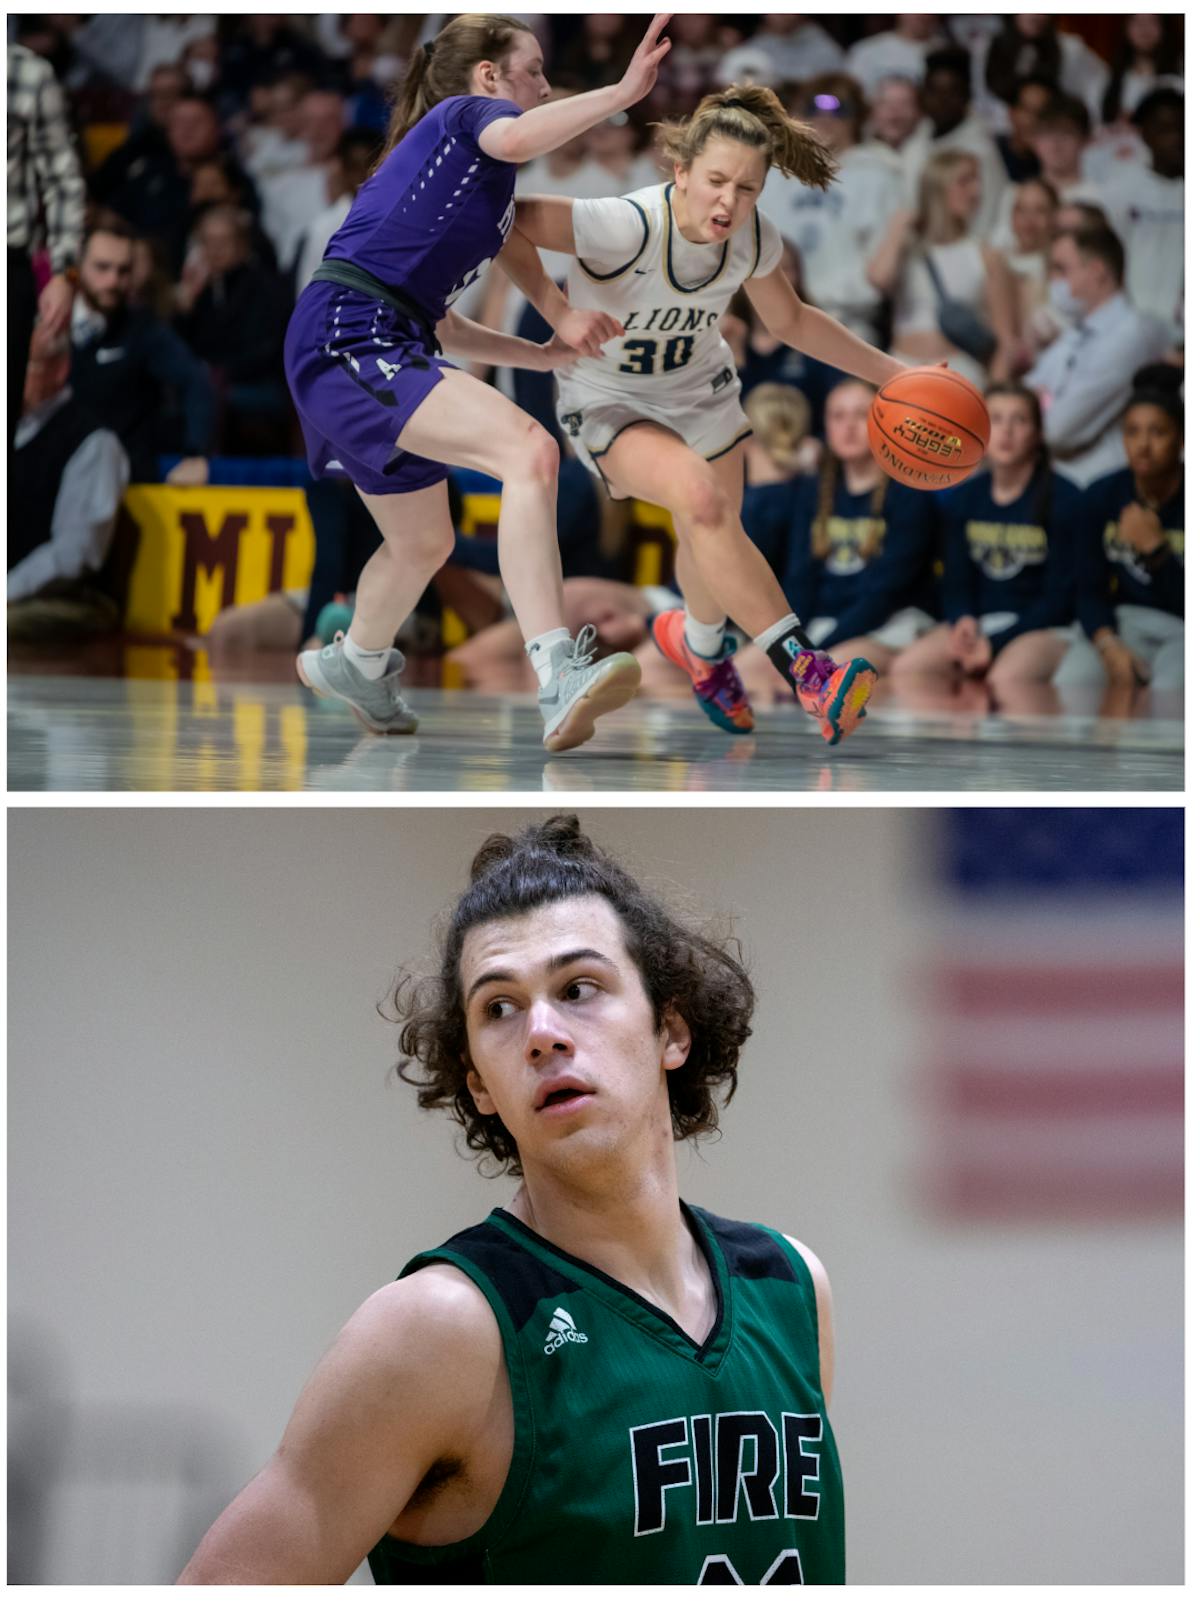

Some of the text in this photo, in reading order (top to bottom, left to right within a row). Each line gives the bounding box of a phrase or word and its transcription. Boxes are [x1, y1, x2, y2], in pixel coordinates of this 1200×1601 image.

[623, 306, 719, 333] LIONS
[618, 334, 696, 375] 30
[893, 424, 962, 460] LEGACY
[543, 1328, 589, 1355] adidas
[629, 1410, 823, 1538] FIRE
